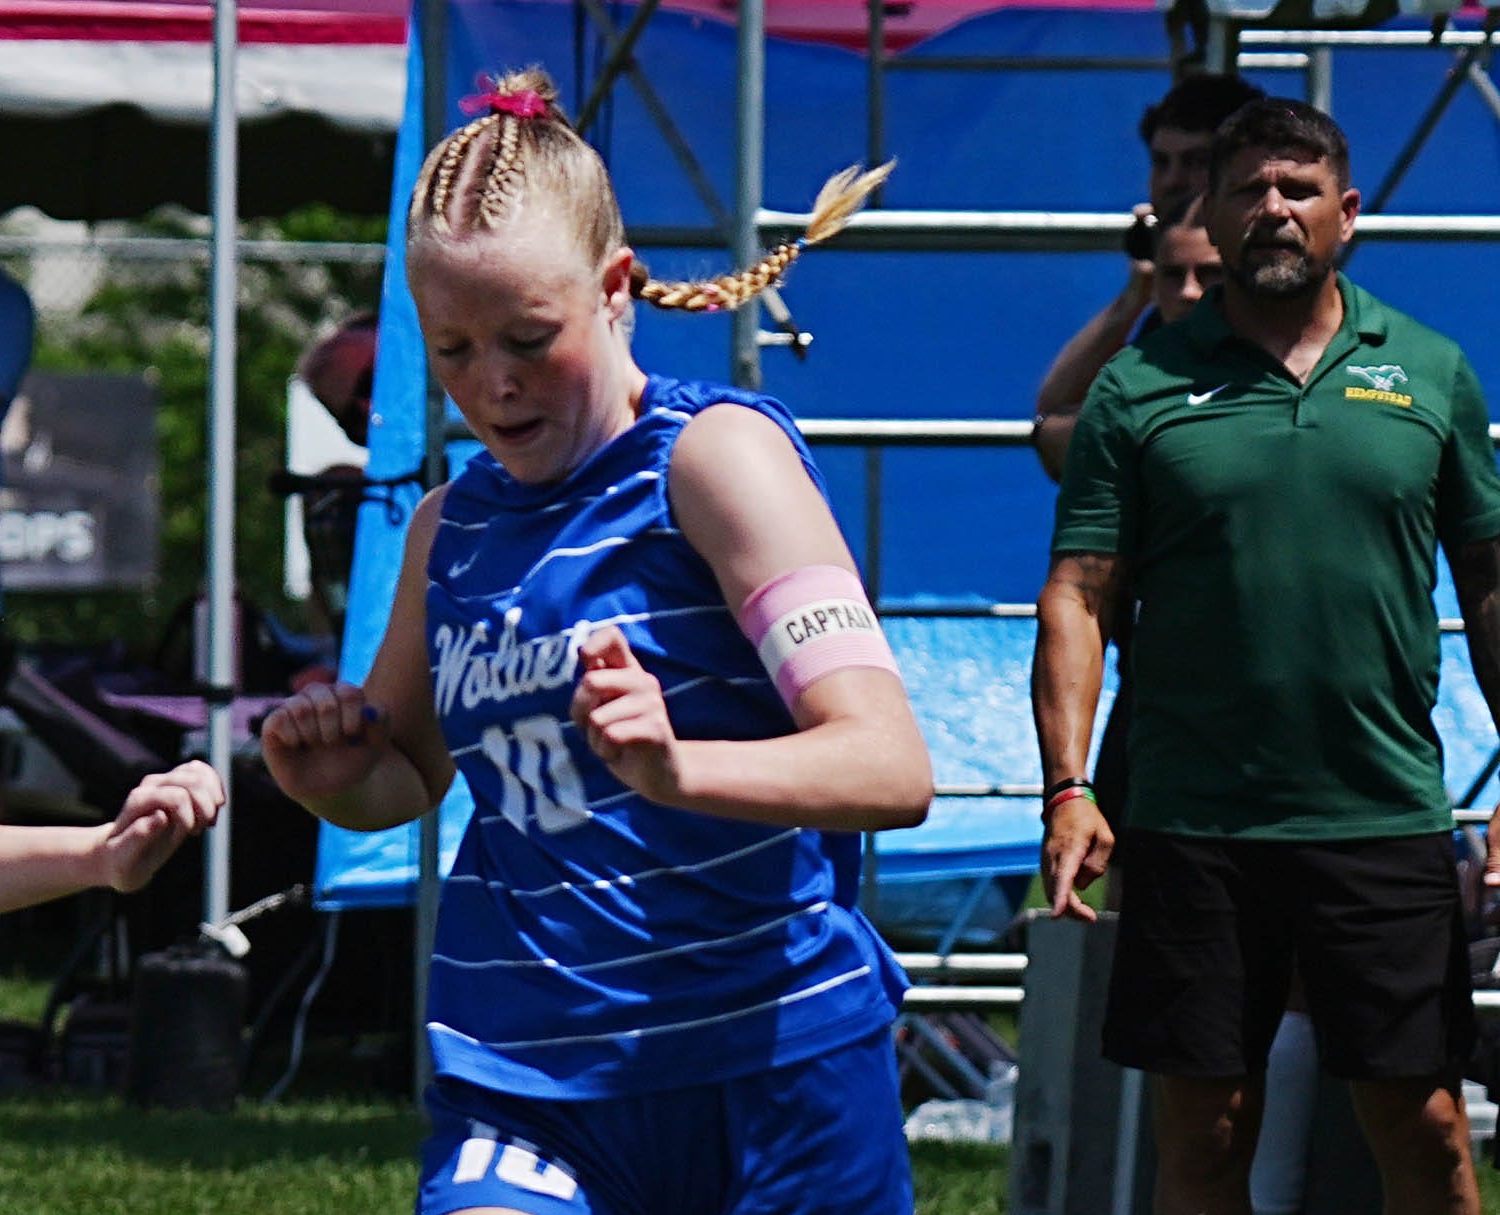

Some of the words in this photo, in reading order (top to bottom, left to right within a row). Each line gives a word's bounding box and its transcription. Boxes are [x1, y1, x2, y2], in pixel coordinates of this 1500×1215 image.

[786, 604, 874, 644] CAPTAIN
[482, 714, 590, 836] 10
[451, 1117, 578, 1200] 10
